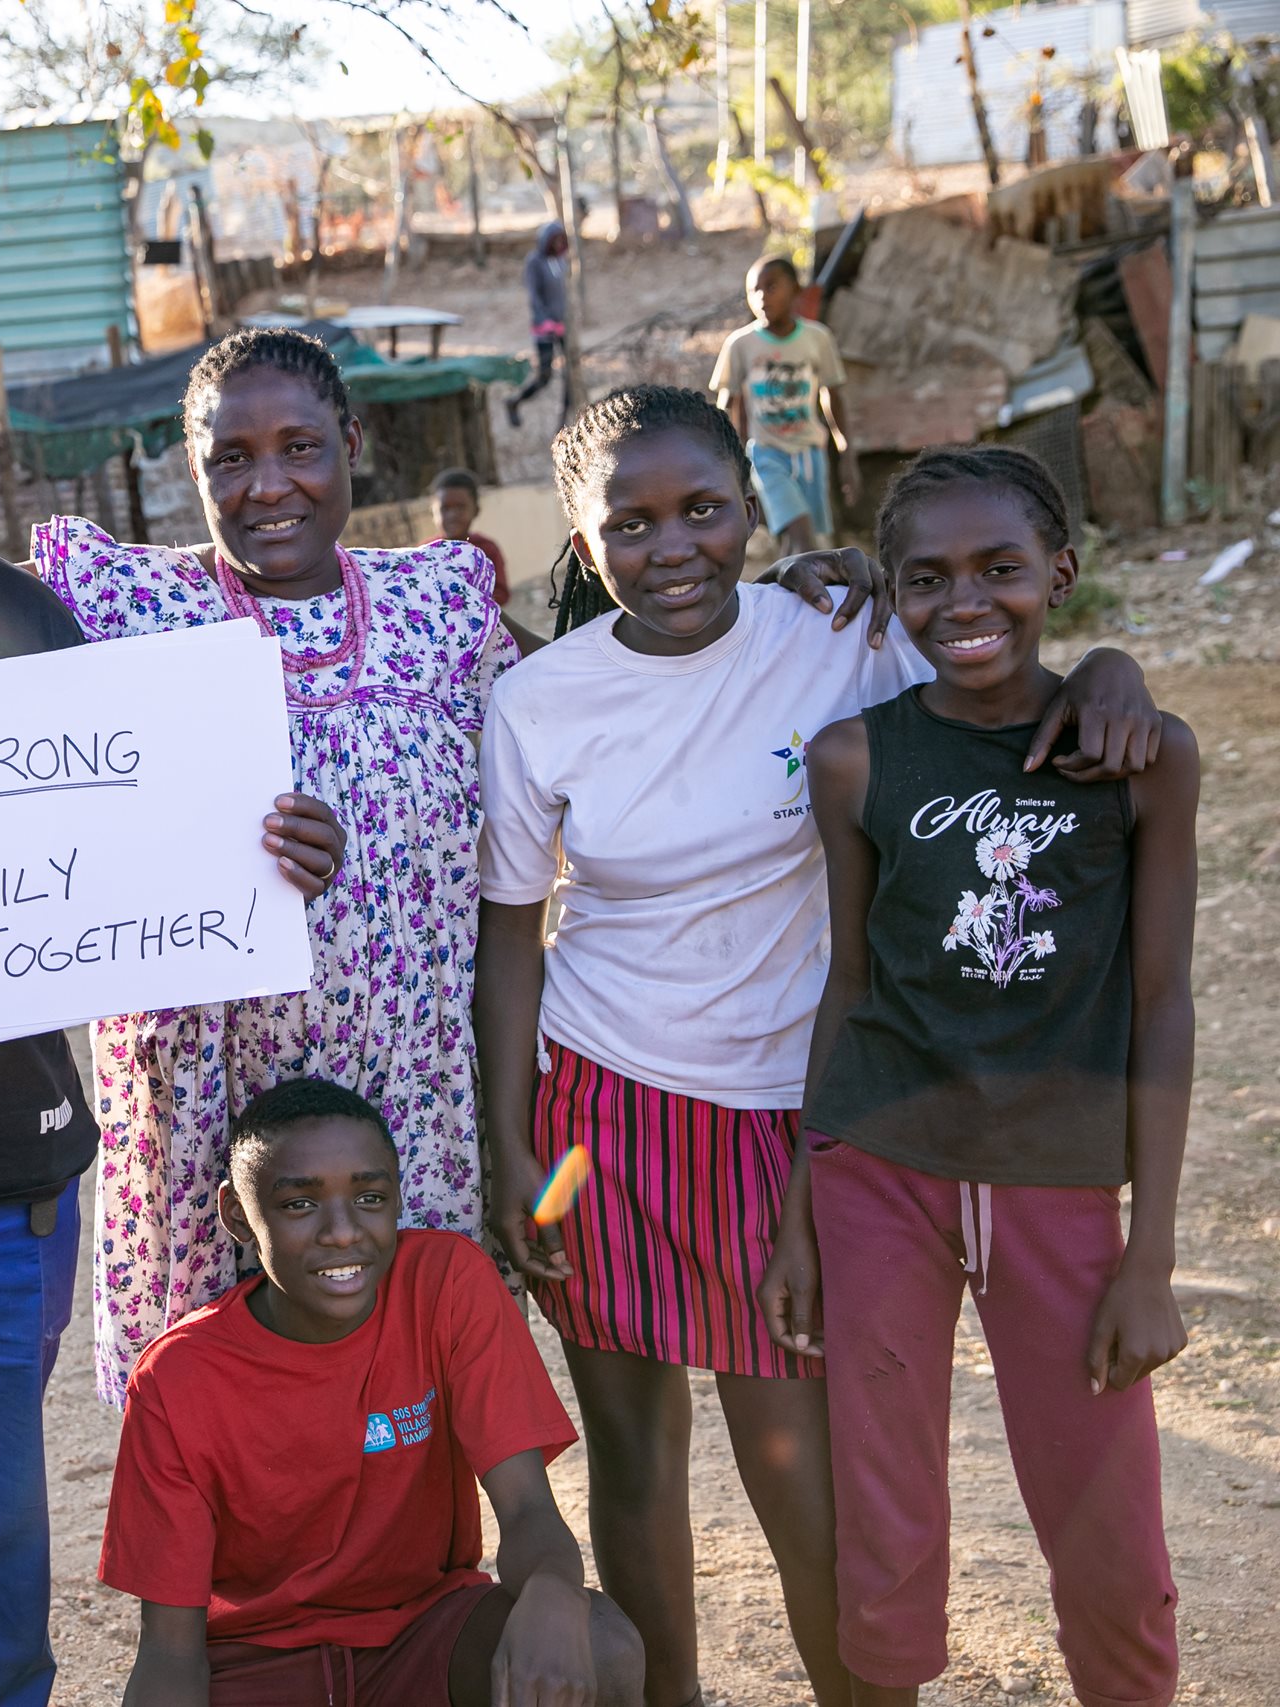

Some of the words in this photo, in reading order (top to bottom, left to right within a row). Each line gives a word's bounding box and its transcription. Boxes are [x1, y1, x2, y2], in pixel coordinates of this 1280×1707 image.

[1015, 798, 1041, 808] Smiles
[1042, 800, 1056, 808] are
[773, 806, 805, 820] STAR
[910, 789, 1080, 853] Always
[392, 1406, 411, 1421] SOS
